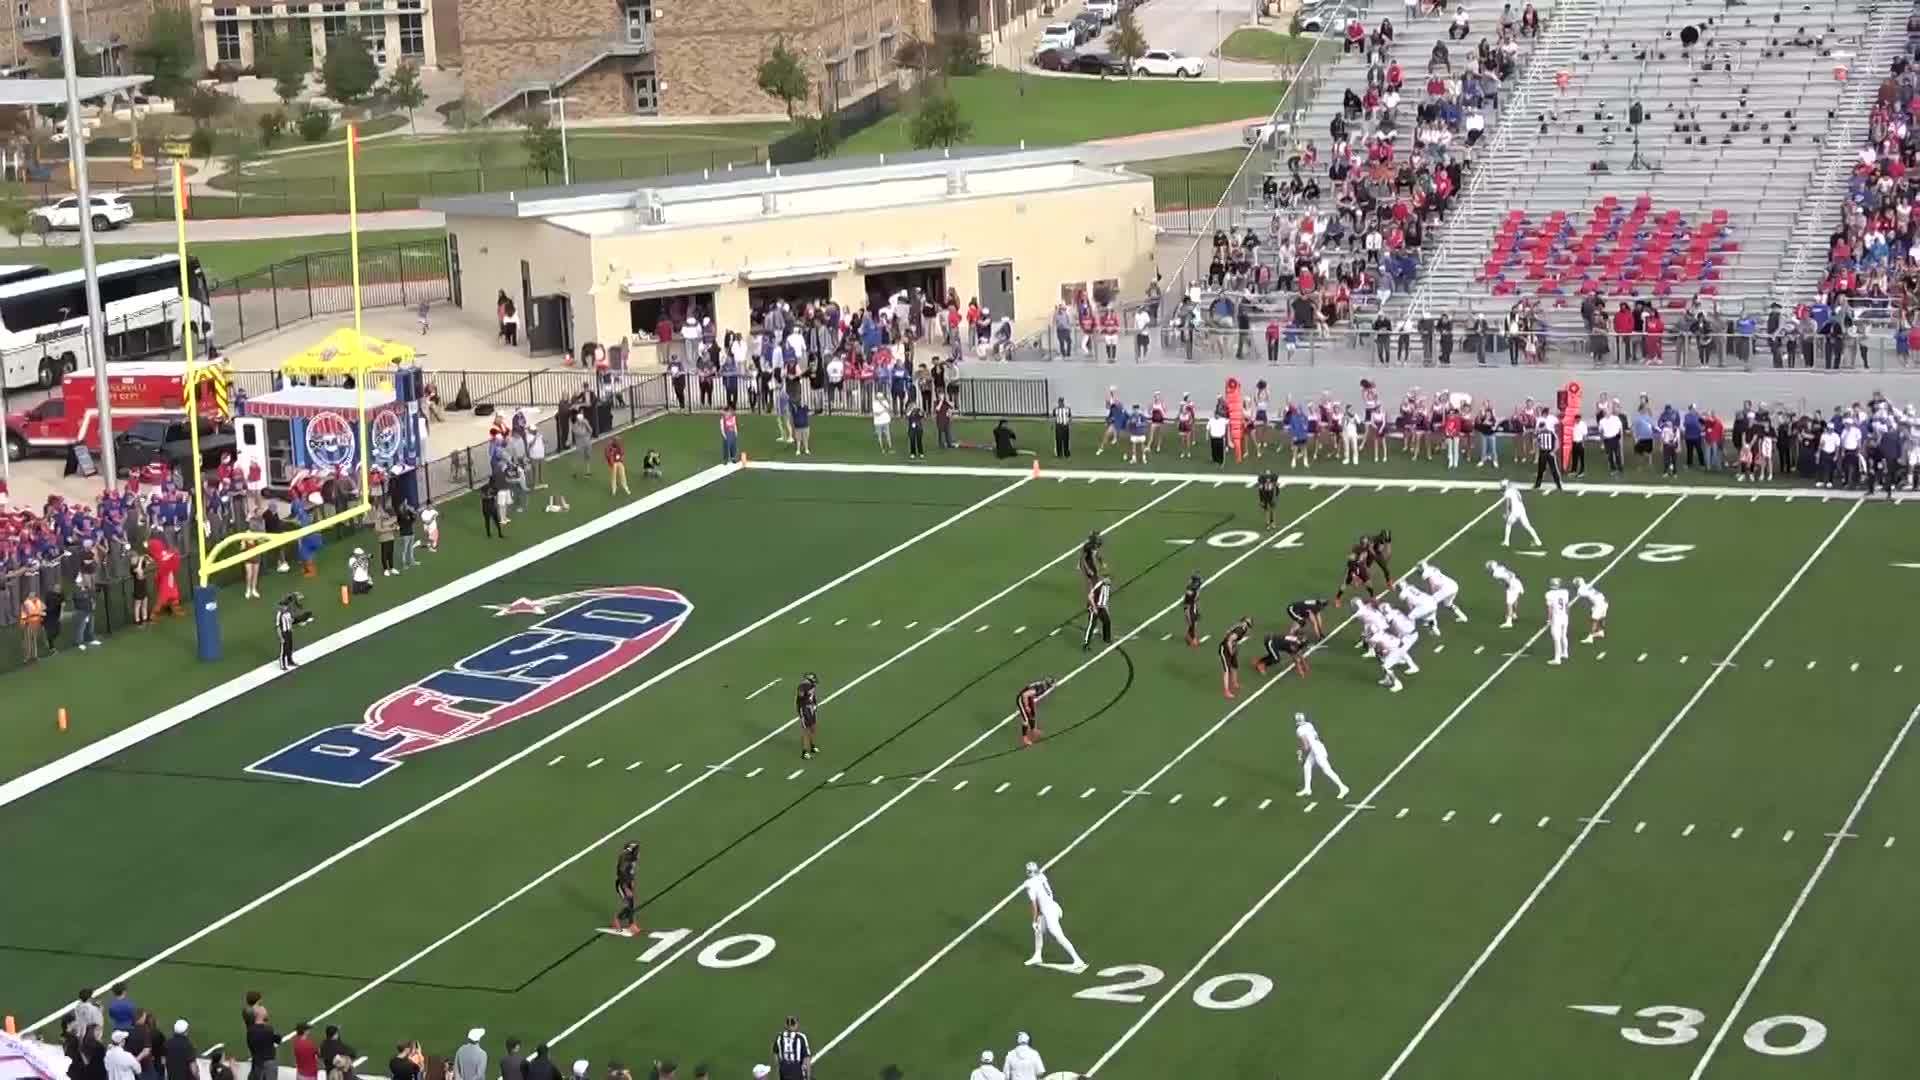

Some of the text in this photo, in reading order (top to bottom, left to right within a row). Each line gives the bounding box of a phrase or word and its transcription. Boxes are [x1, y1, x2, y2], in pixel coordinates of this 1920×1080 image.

[1206, 530, 1304, 549] 10
[1560, 541, 1697, 562] 20
[635, 928, 777, 969] 10
[1072, 963, 1274, 1010] 20
[1620, 1005, 1828, 1056] 30
